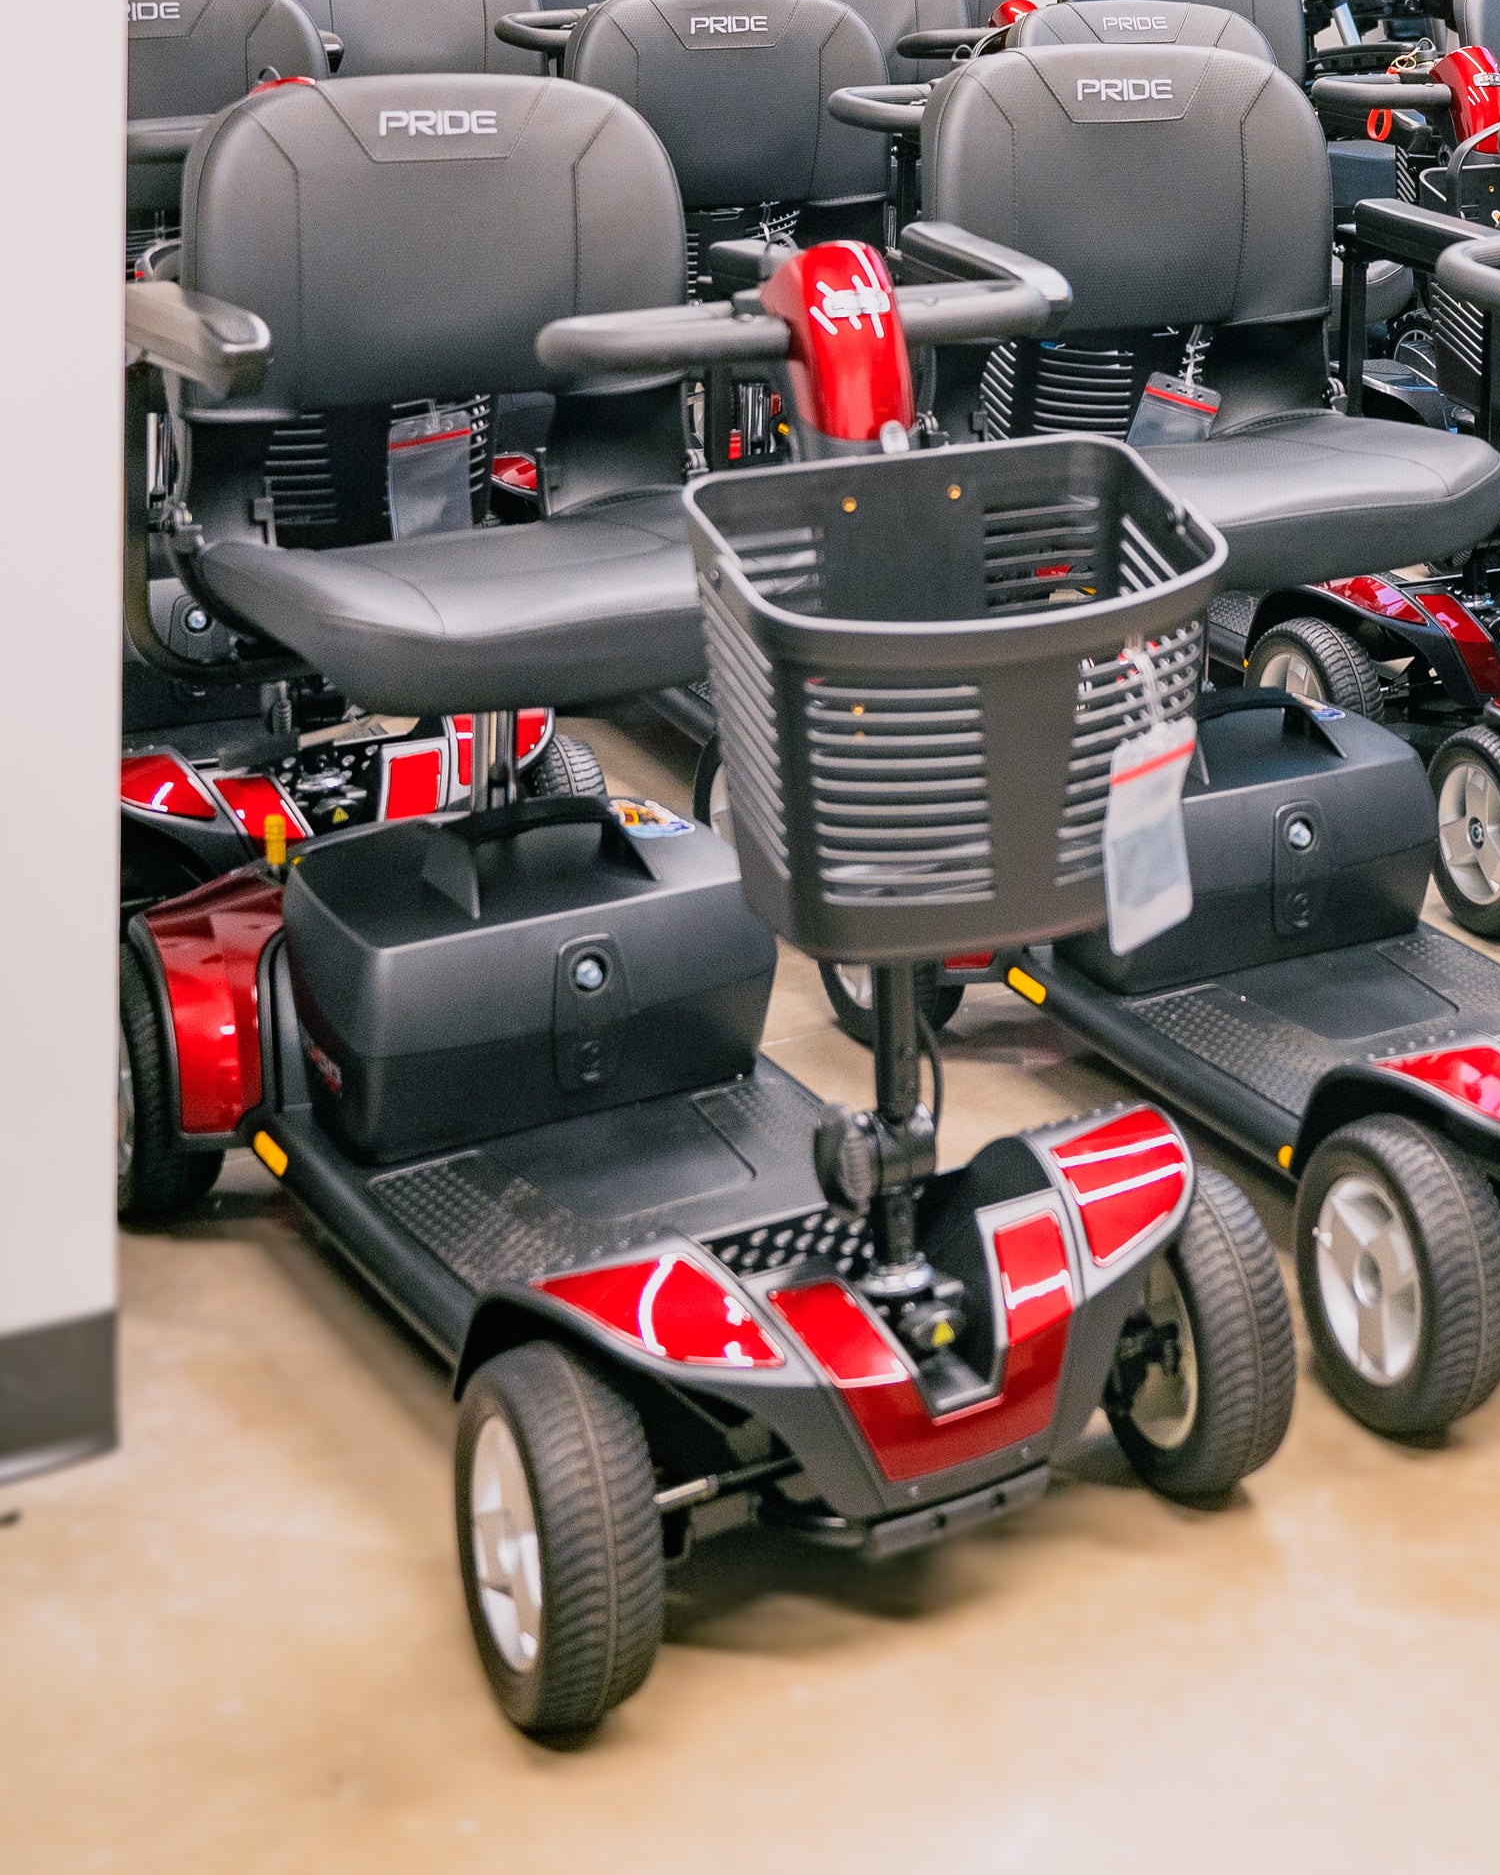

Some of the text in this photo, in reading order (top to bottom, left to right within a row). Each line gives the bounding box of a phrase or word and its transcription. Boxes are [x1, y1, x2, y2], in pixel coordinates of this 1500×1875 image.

[128, 1, 180, 20] IDE
[690, 15, 768, 34] PRIDE
[1103, 16, 1167, 31] PRIDE
[1076, 79, 1172, 101] PRIDE
[379, 109, 497, 136] PRIDE
